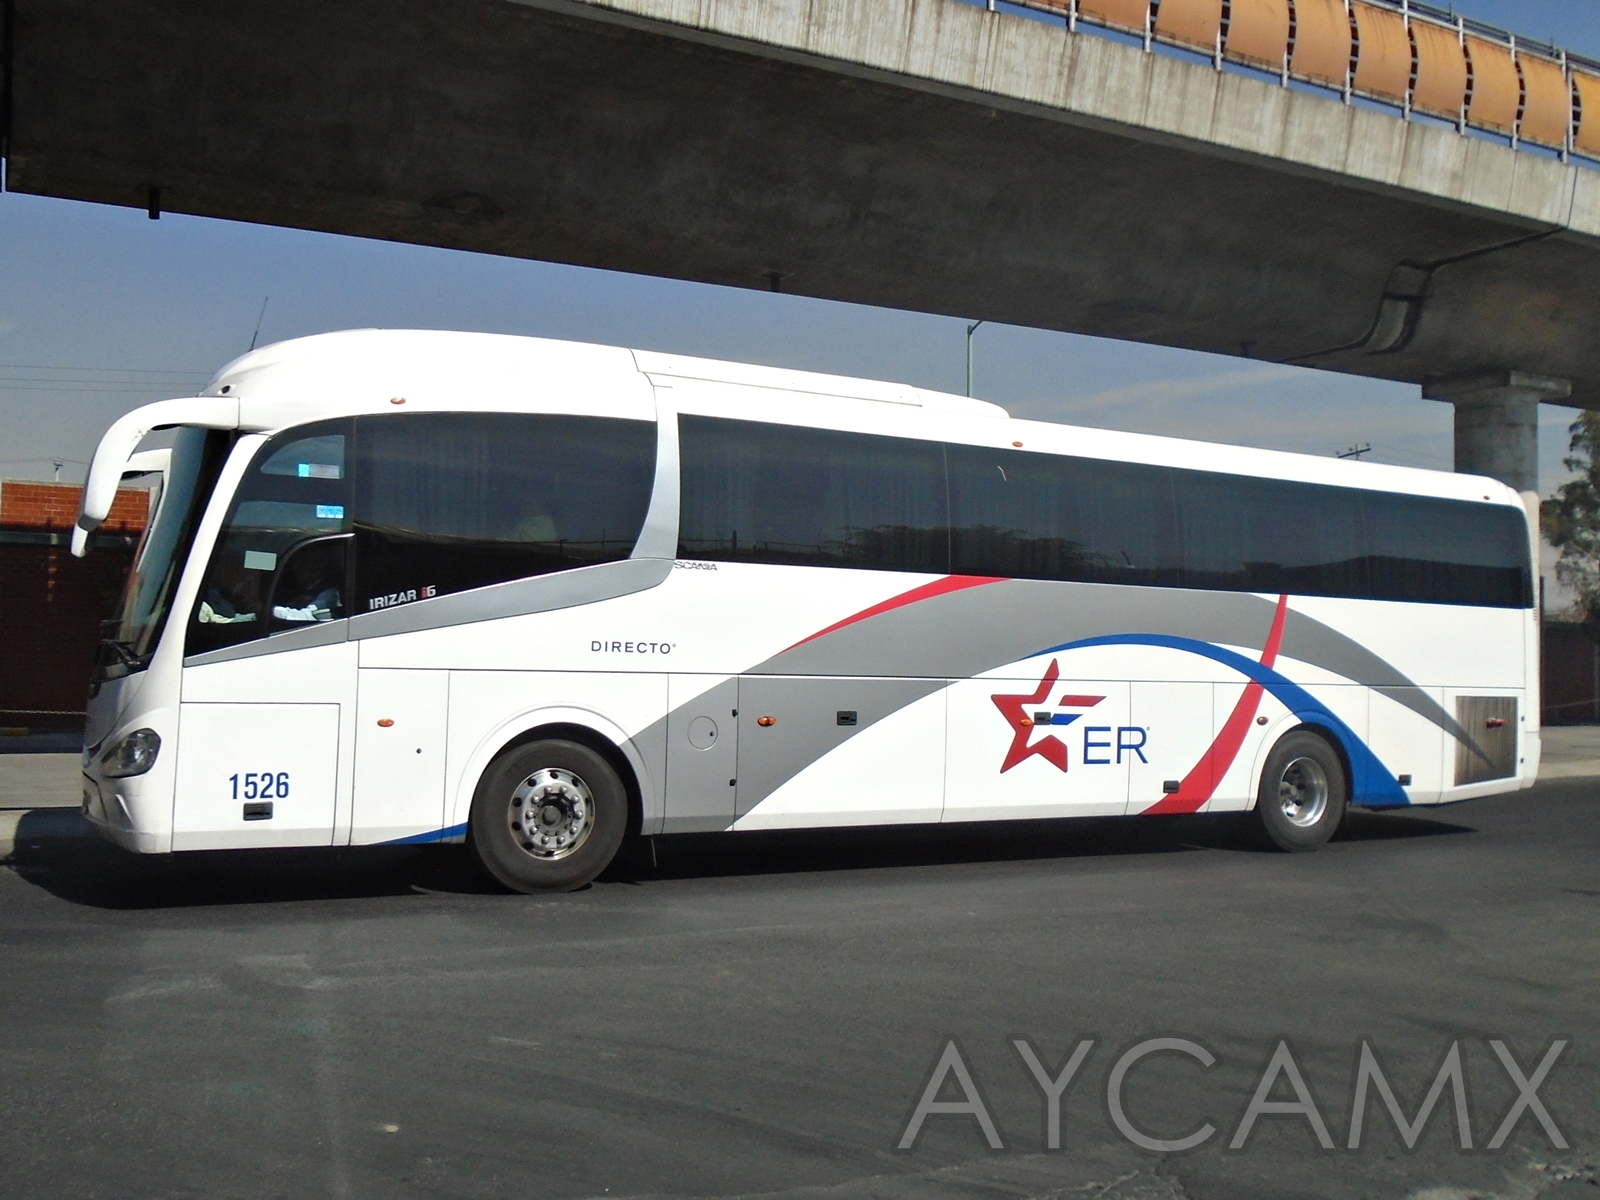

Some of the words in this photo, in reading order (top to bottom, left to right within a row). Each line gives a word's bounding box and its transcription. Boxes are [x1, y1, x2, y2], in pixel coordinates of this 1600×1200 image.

[673, 560, 718, 571] SCANIA
[369, 589, 417, 610] IRIZAR
[421, 585, 436, 599] i6
[591, 640, 671, 655] DIRECTO
[1083, 726, 1149, 765] ER
[229, 772, 289, 800] 1526
